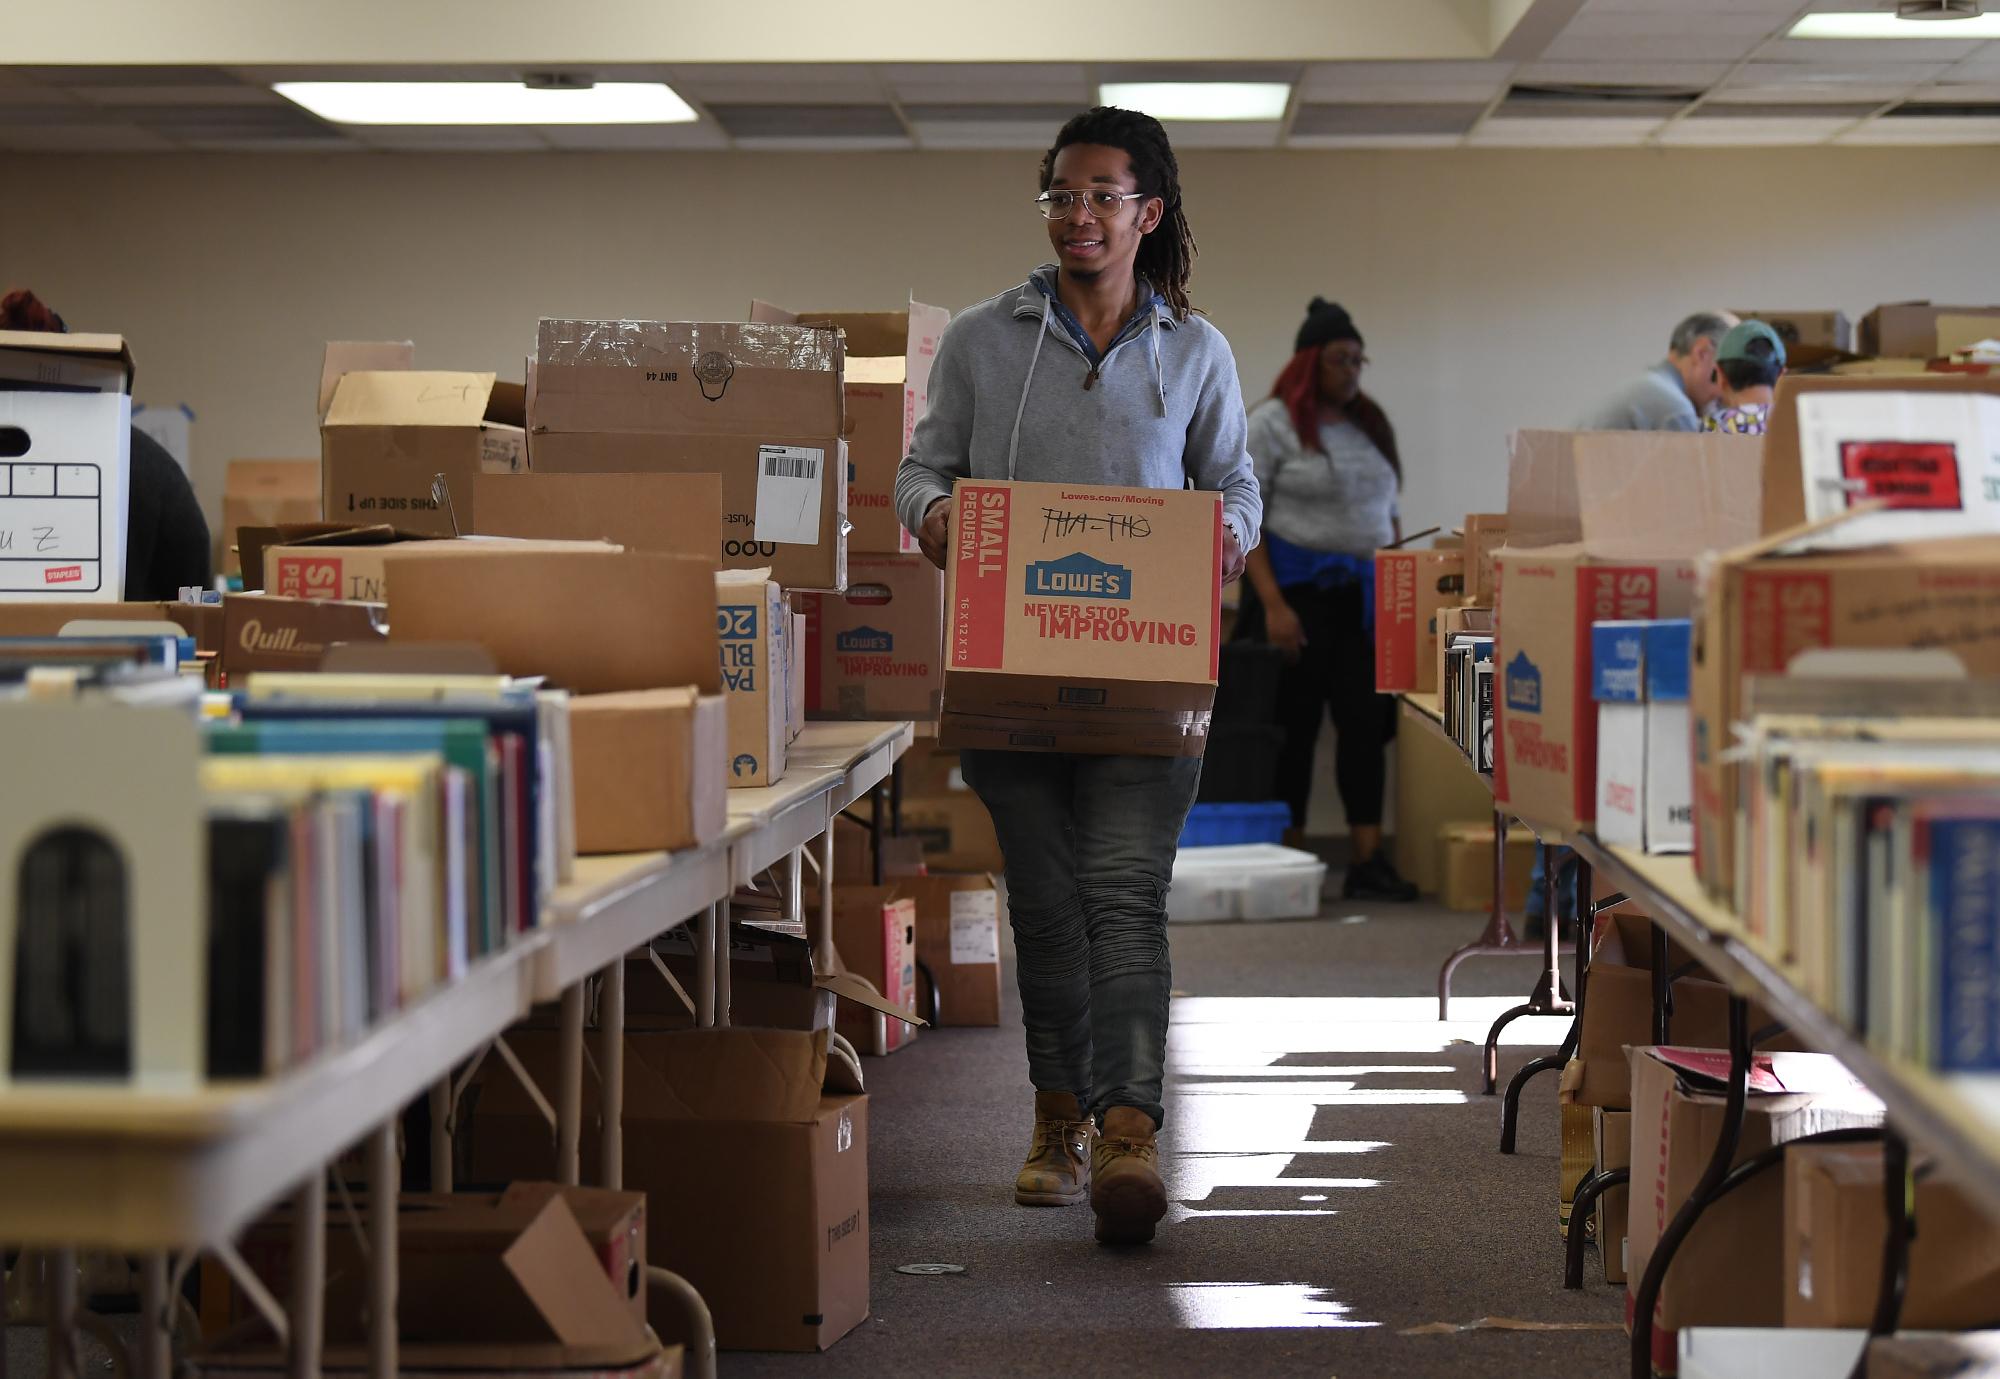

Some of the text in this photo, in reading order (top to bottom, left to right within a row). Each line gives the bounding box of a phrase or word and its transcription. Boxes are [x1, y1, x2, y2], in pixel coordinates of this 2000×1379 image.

[646, 372, 677, 381] BNT 44
[360, 498, 438, 510] THIS SIDE UP
[847, 493, 889, 507] OVING
[1061, 491, 1165, 506] Lowes.com/Moving
[960, 491, 978, 560] PEQUEÑA
[978, 492, 1006, 578] SMALL
[721, 540, 776, 563] noo
[1037, 568, 1120, 594] LOWE'S
[1395, 559, 1413, 625] SMALL
[960, 598, 969, 609] 16
[1023, 603, 1130, 621] NEVER STOP
[959, 624, 968, 635] 12
[843, 636, 887, 649] LOWE'S
[958, 650, 967, 661] 12
[845, 663, 928, 677] IMPROVING
[721, 669, 756, 691] PA
